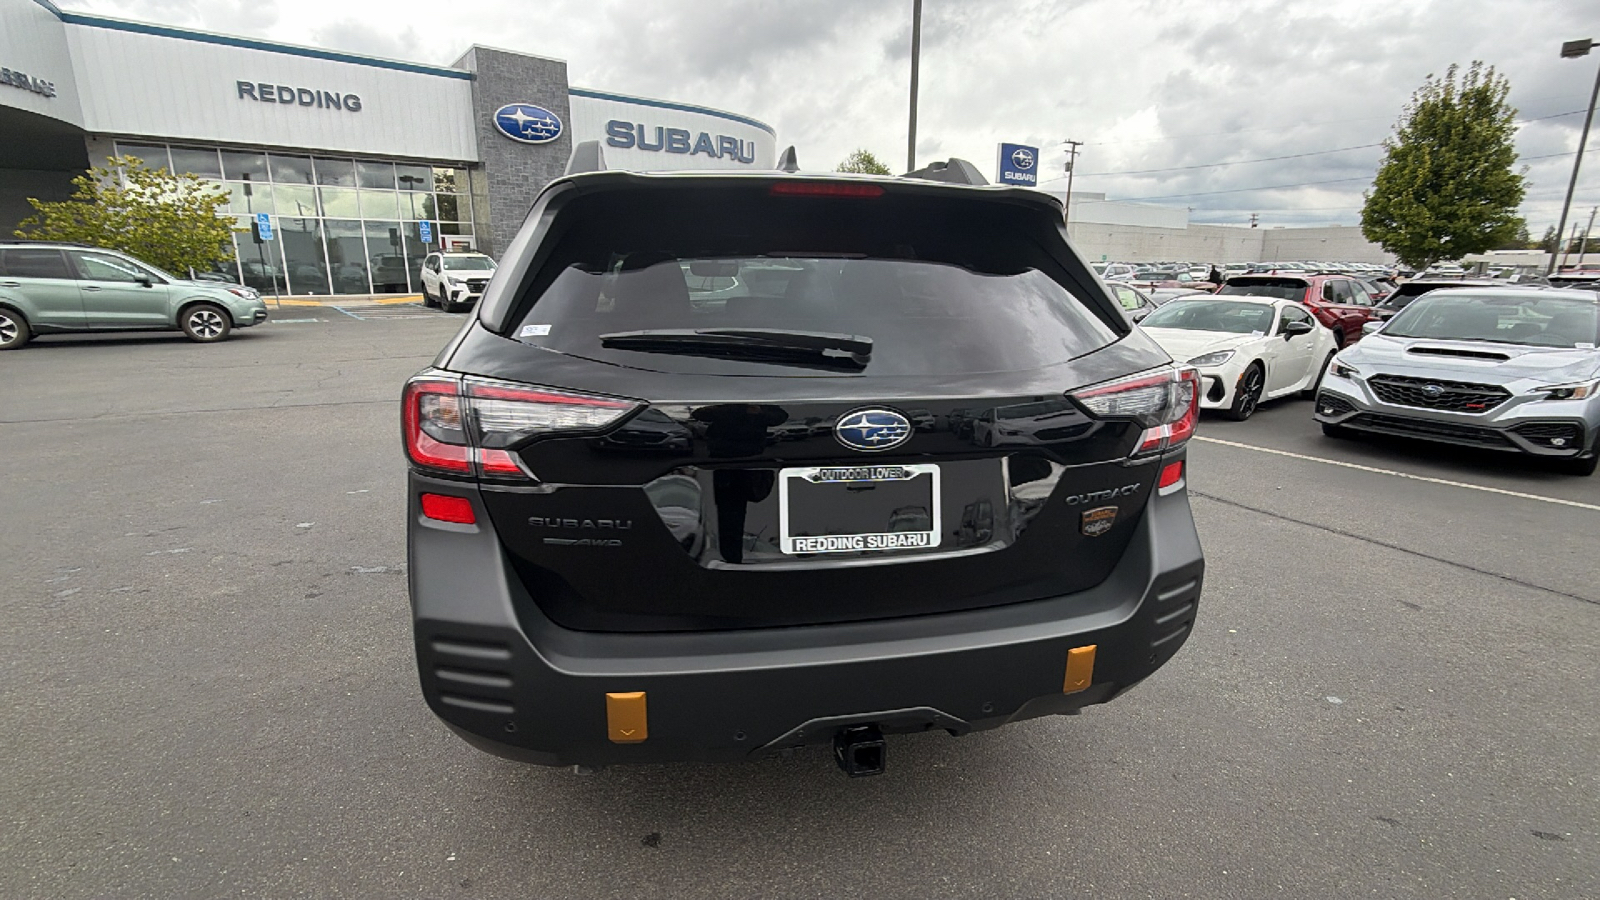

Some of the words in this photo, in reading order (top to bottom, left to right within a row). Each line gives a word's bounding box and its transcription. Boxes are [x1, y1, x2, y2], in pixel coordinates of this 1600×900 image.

[236, 80, 362, 112] REDDING
[606, 119, 755, 164] SUBARU
[1004, 171, 1036, 182] SUBARU
[821, 468, 869, 480] OUTDOOR
[871, 467, 904, 479] LOVER
[1066, 483, 1140, 505] OUTBACK
[528, 516, 632, 529] SUBARU
[574, 538, 622, 546] AWD
[796, 536, 863, 551] REDDING
[867, 533, 928, 548] SUBARU
